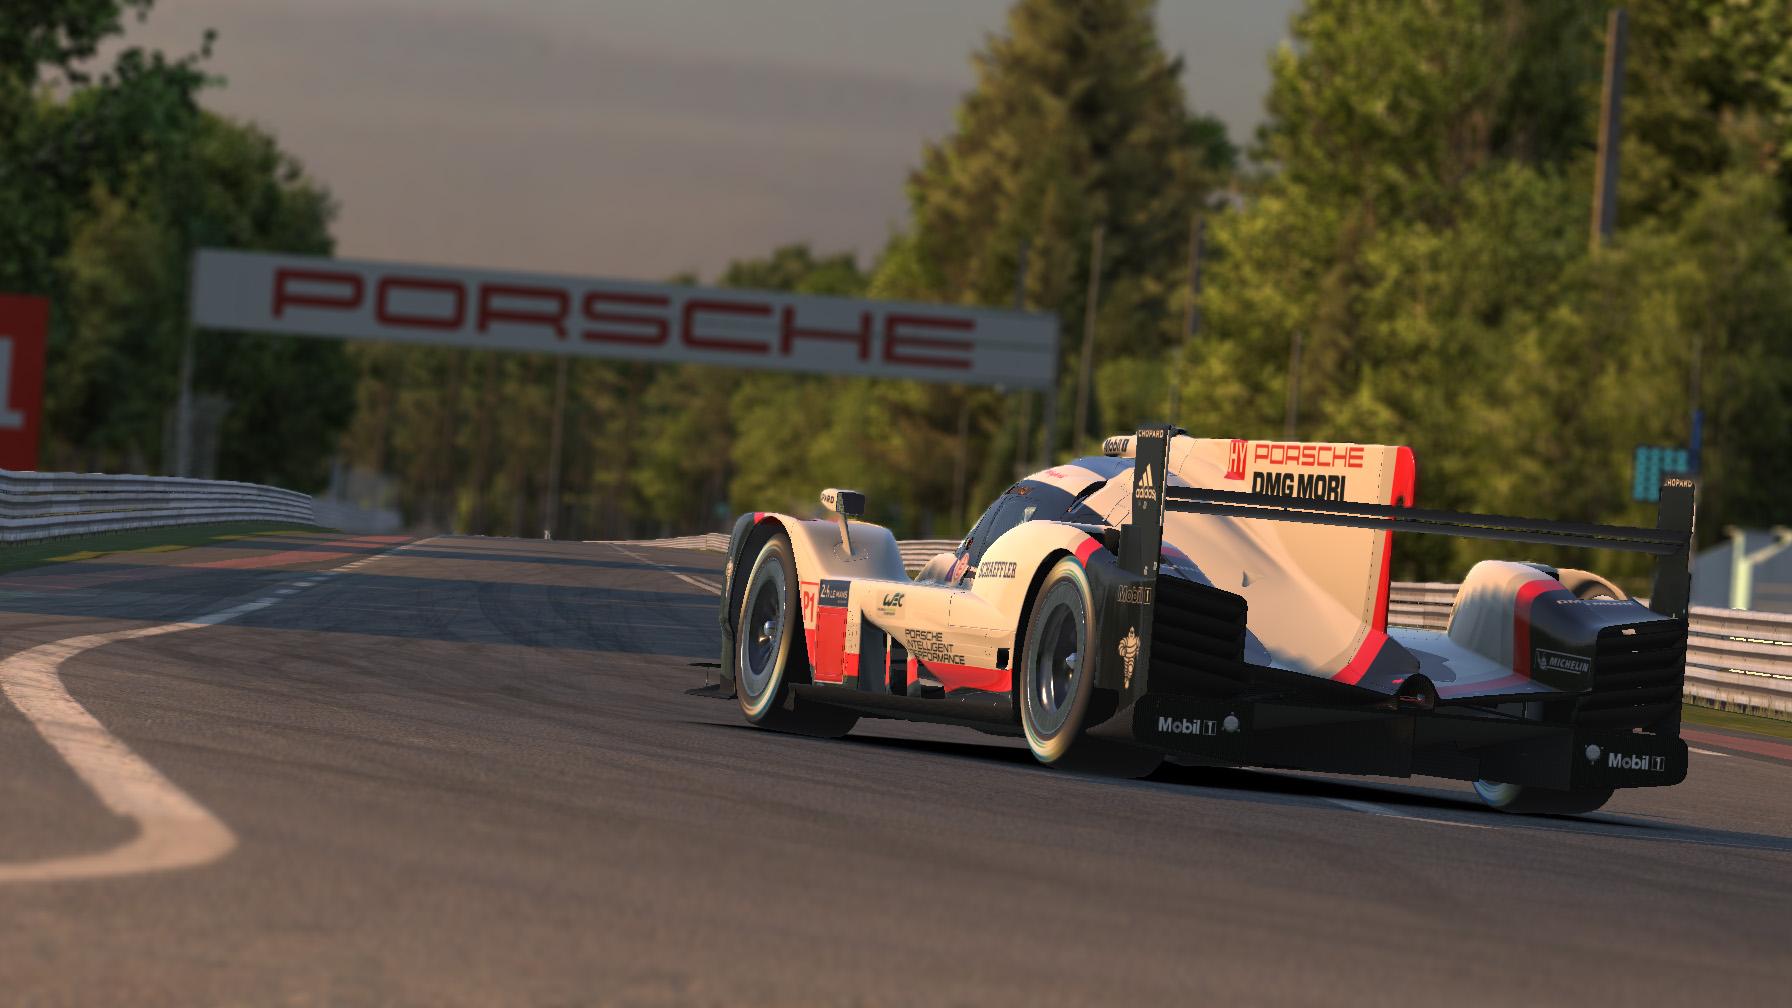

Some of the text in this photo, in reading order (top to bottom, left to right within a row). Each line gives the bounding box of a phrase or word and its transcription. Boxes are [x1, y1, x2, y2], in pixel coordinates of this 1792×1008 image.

[272, 266, 976, 370] PORSCHE
[1138, 429, 1164, 438] CHOPARD
[1104, 438, 1121, 453] Mobil
[1229, 439, 1248, 474] HY
[1254, 443, 1365, 469] PORSCHE
[1136, 487, 1156, 502] adidas
[1251, 471, 1346, 502] DMG MORI
[977, 561, 1018, 579] SCHAEFFLER
[882, 592, 905, 608] WEC
[1117, 584, 1143, 604] Mobil
[803, 590, 815, 623] P1
[904, 628, 943, 642] PORSCHE
[1549, 656, 1590, 673] MICHELIN
[1158, 716, 1200, 735] Mobil
[1608, 752, 1649, 771] Mobil
